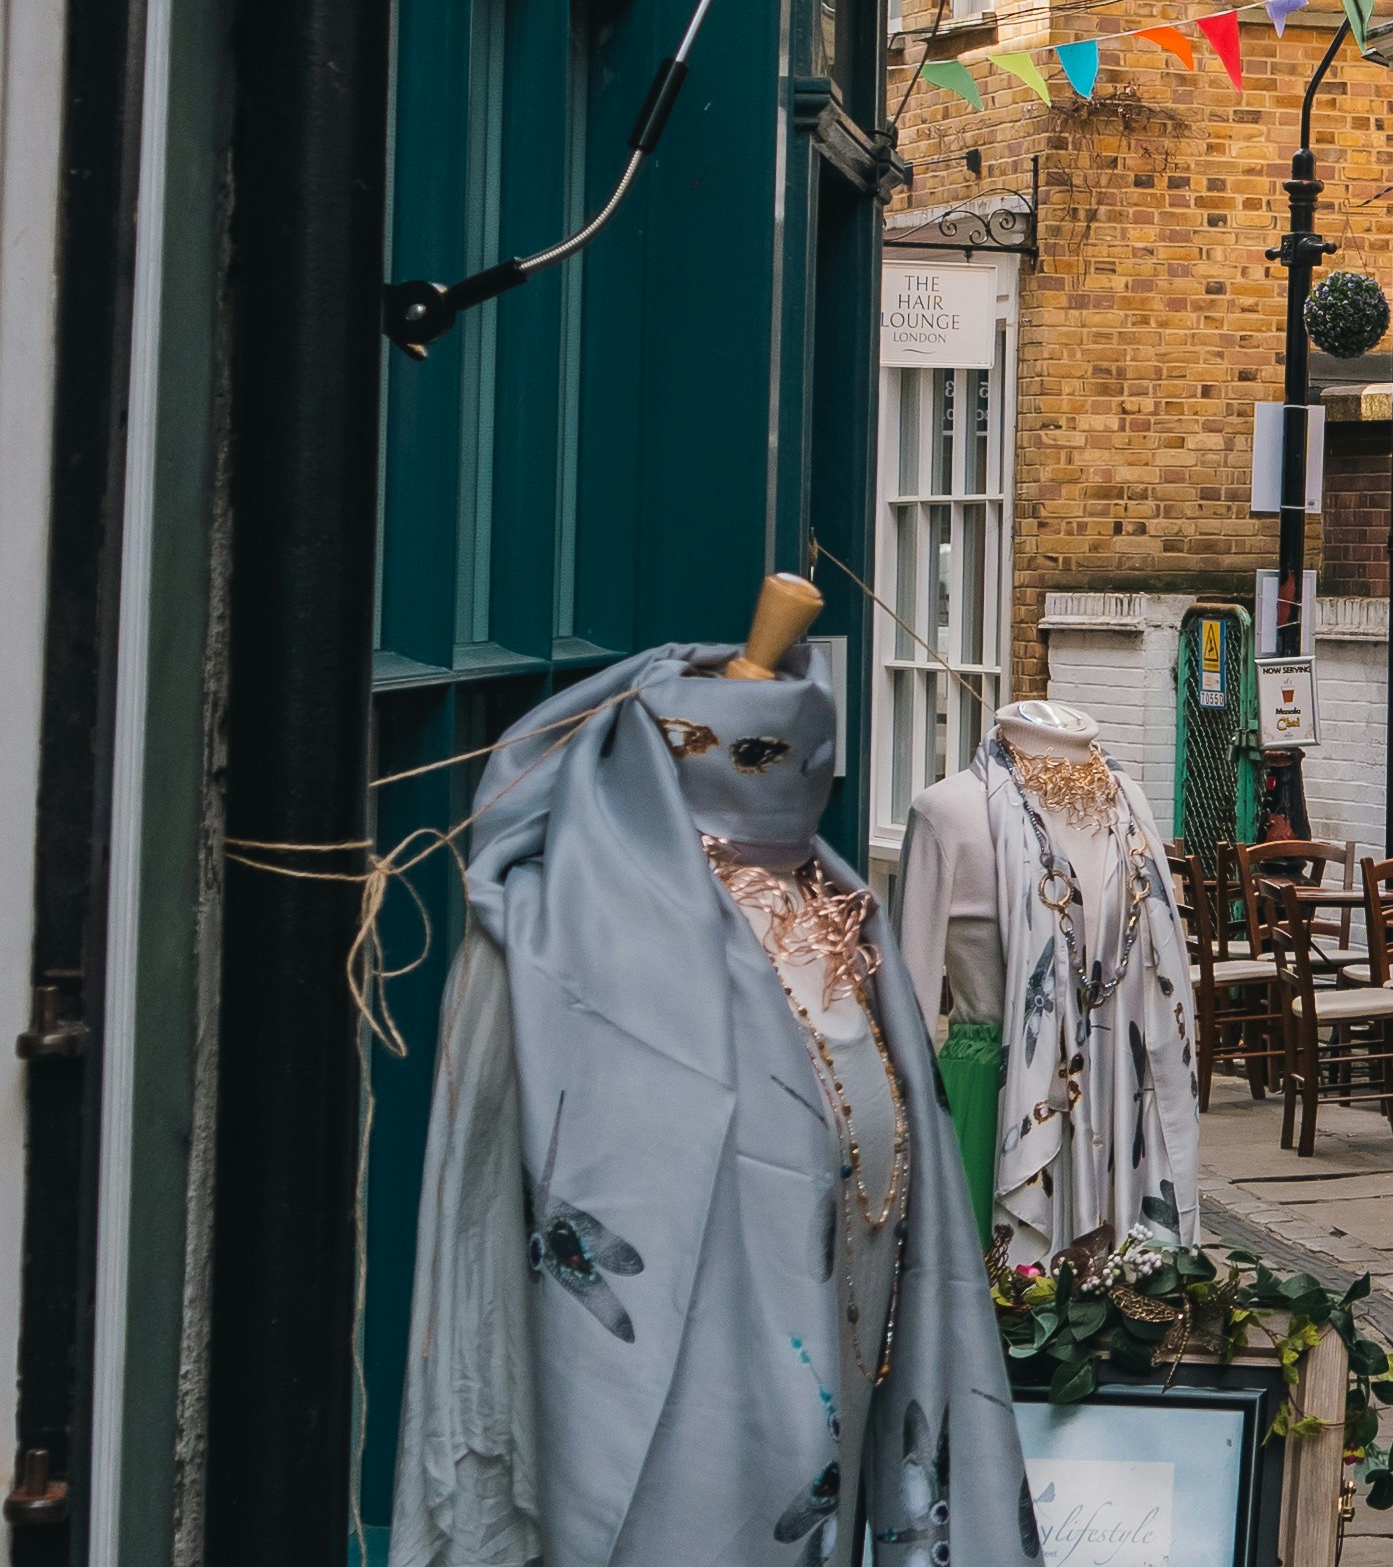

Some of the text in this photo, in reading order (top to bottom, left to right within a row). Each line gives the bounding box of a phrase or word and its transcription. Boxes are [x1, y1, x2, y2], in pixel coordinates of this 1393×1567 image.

[904, 275, 940, 292] THE
[898, 294, 943, 311] HAIR
[880, 312, 960, 330] LOUNGE
[893, 332, 947, 344] LONDON
[1263, 666, 1281, 675] NOW
